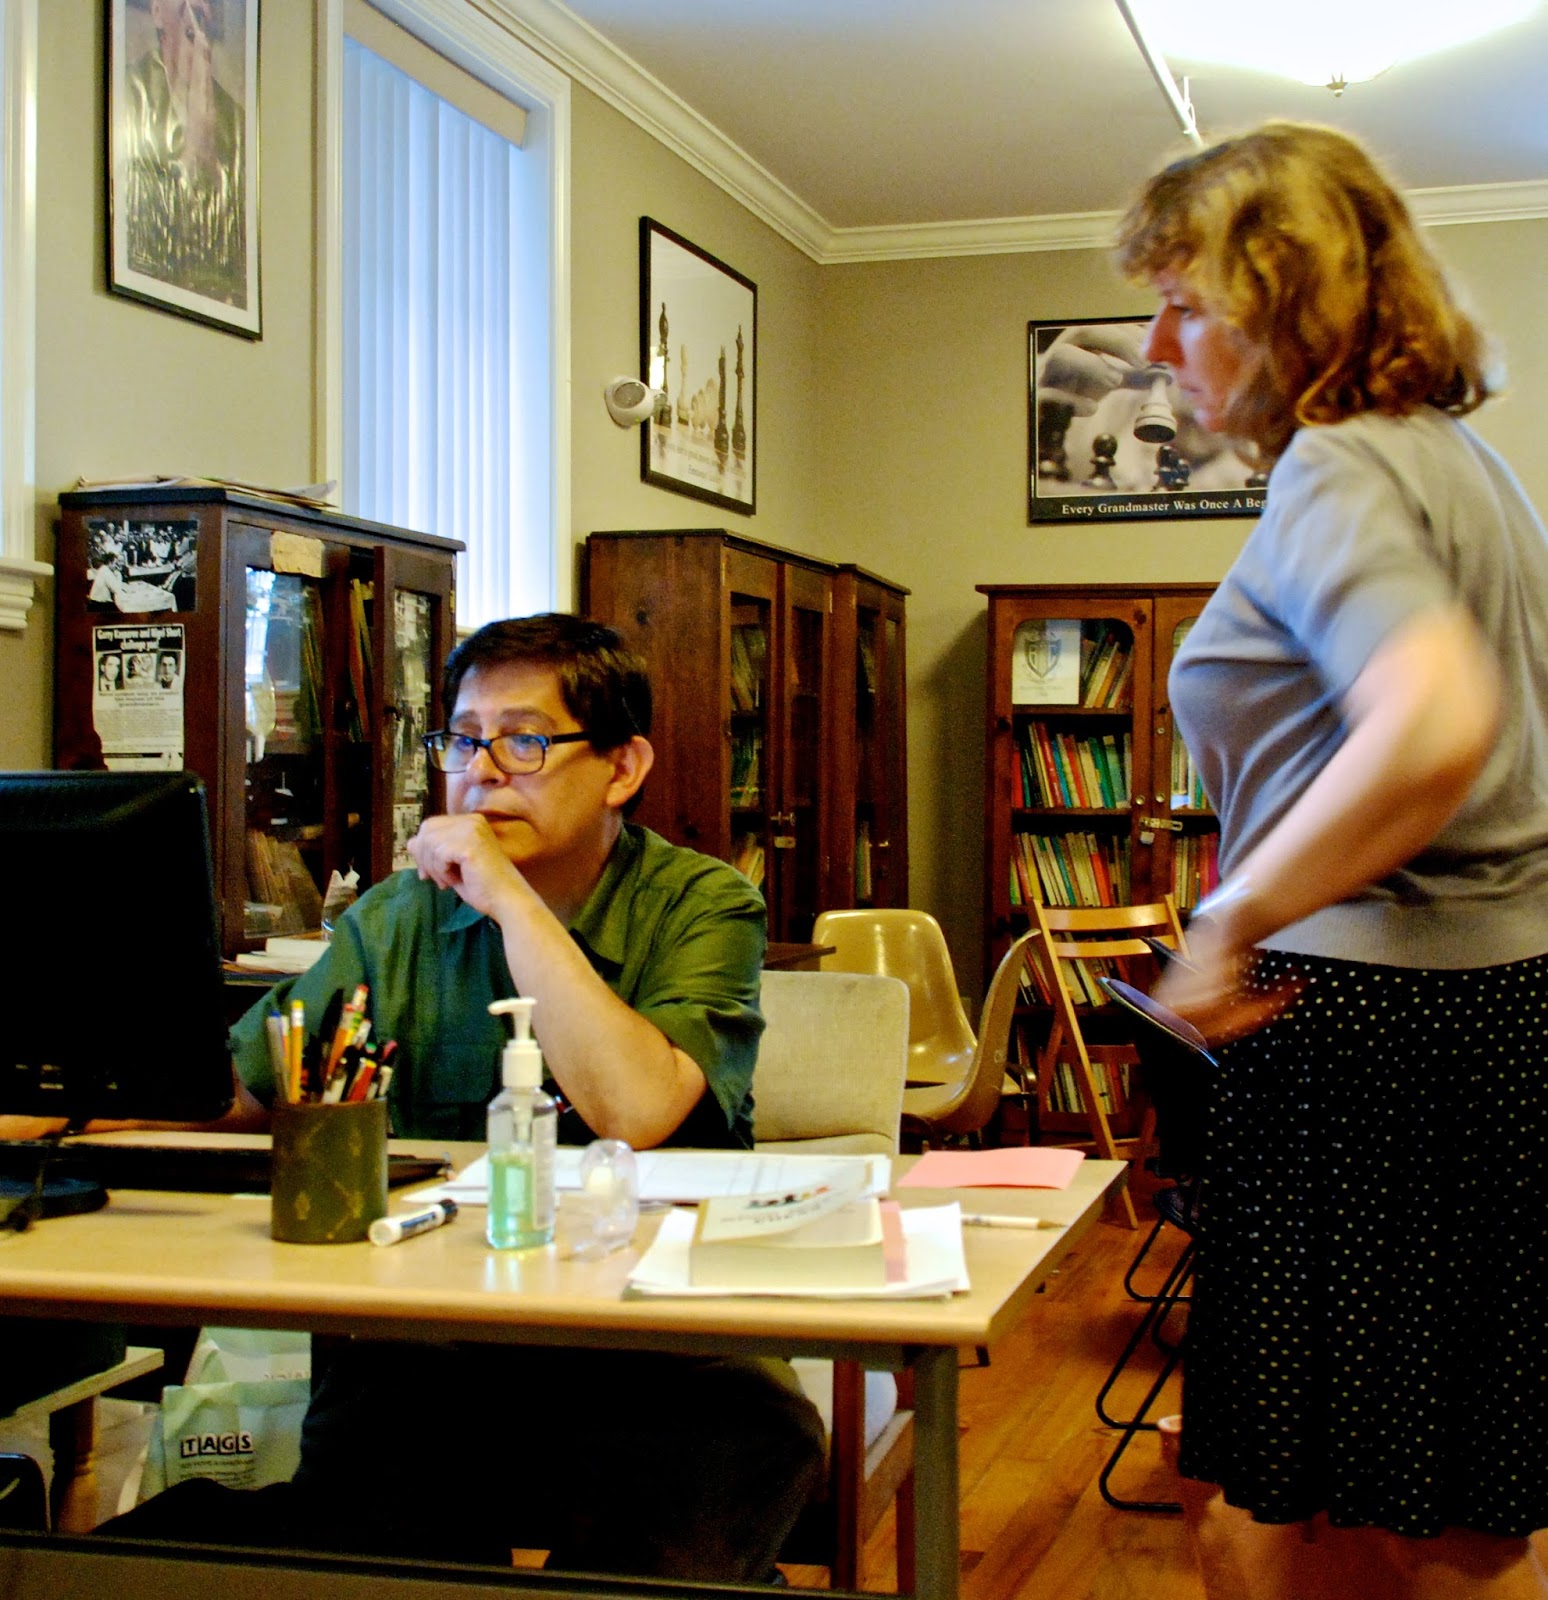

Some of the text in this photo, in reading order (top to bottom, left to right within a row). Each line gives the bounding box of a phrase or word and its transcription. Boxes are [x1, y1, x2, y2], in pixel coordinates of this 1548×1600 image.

[1062, 503, 1094, 516] Every
[1098, 501, 1169, 514] Grandmaster
[1173, 500, 1196, 511] Was
[1200, 499, 1230, 510] Once
[1233, 498, 1243, 509] A
[184, 1434, 252, 1453] TAGS
